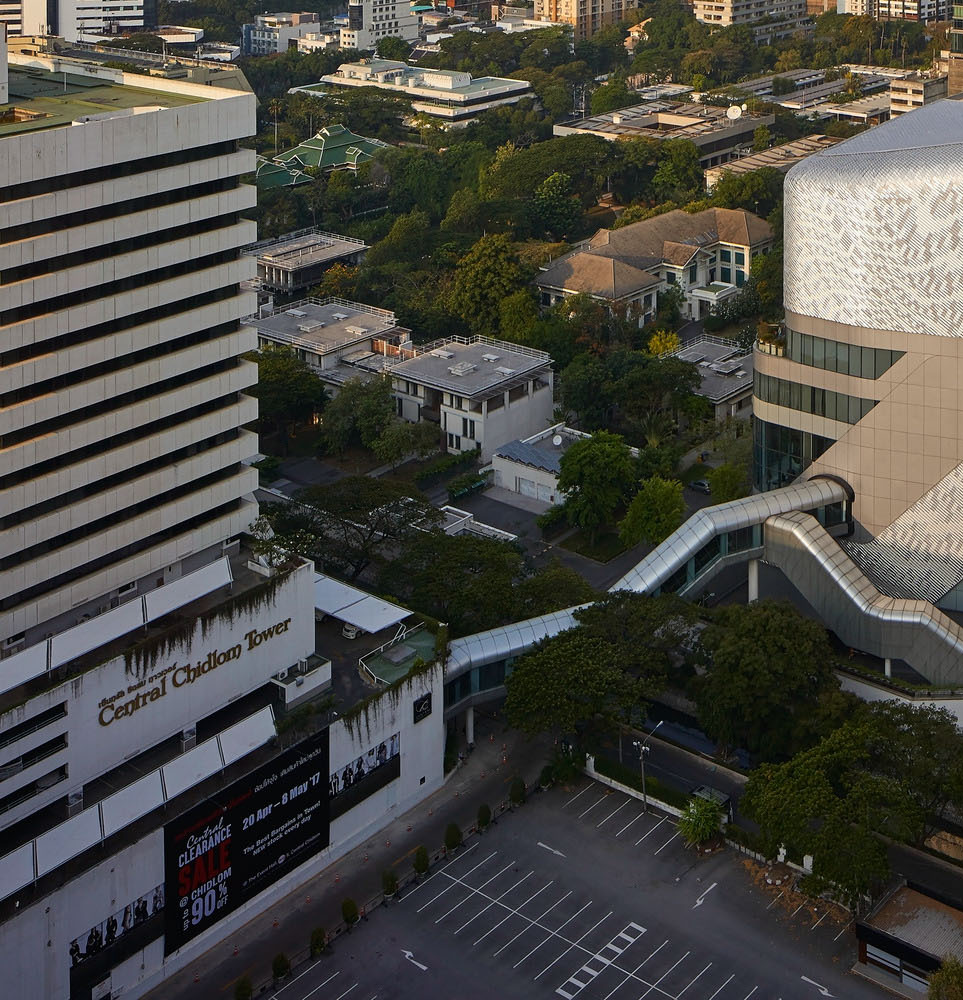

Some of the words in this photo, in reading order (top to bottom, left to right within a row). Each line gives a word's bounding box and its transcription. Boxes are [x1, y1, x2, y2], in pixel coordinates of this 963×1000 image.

[98, 676, 167, 726] Central
[172, 644, 242, 688] Chidlom
[244, 618, 292, 652] Tower
[242, 813, 255, 831] 20
[256, 803, 273, 823] Apr
[281, 792, 289, 805] 8
[289, 781, 308, 801] May
[178, 823, 232, 868] CLEARANCE
[187, 816, 224, 849] Central
[243, 844, 255, 855] The
[256, 833, 270, 847] Best
[271, 817, 297, 837] Bargains
[252, 844, 266, 856] NEW
[267, 833, 284, 847] stock
[284, 821, 301, 835] every
[301, 814, 312, 825] day
[177, 839, 232, 897] SALE
[191, 867, 232, 901] CHIDLOM
[216, 894, 229, 909] OFF
